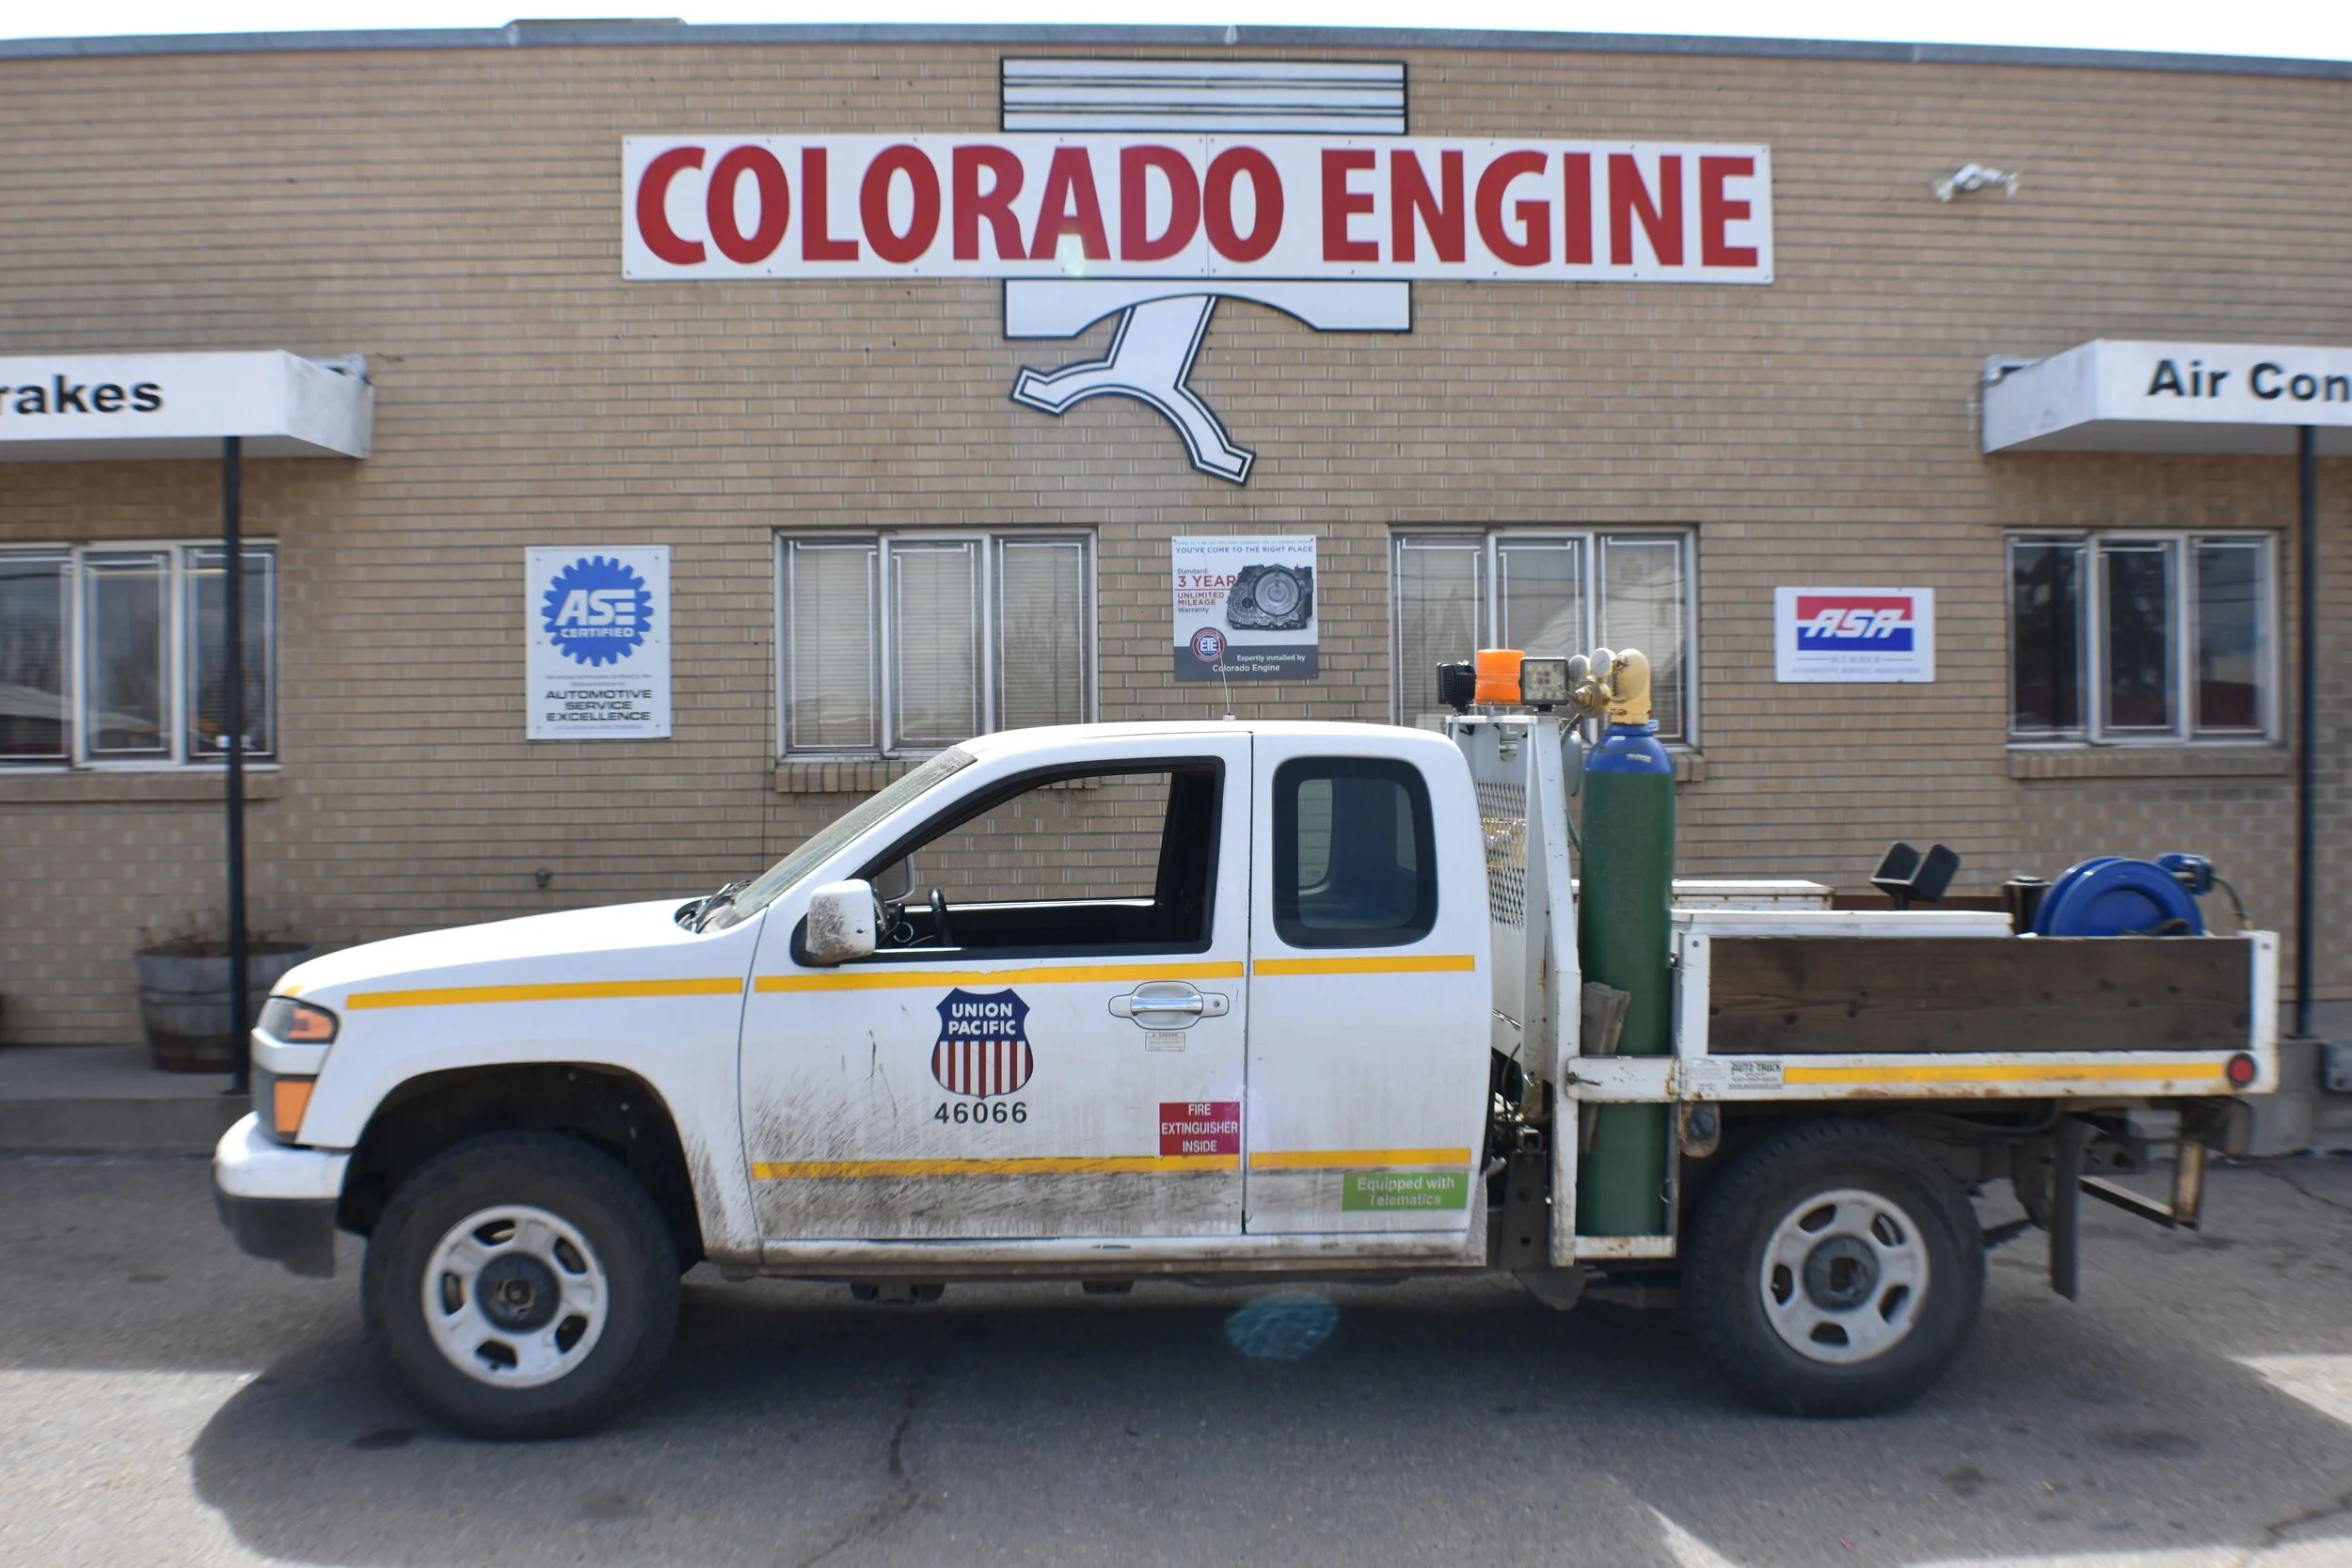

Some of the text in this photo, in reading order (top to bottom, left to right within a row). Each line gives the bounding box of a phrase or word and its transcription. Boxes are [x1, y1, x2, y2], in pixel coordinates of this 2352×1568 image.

[635, 143, 1759, 267] COLORADO ENGINE
[2145, 358, 2352, 403] Air Con
[1178, 575, 1236, 588] 3 YEAR
[554, 589, 637, 626] ASE
[1804, 608, 1905, 639] ASA
[560, 627, 635, 638] CERTIFIED
[1200, 637, 1217, 652] ETE
[545, 689, 653, 699] AUTOMOTIVE
[565, 701, 633, 710] SERVICE
[546, 712, 651, 721] EXCELLENCE
[951, 1003, 1013, 1018] UNION
[948, 1021, 1017, 1036] PACIFIC
[934, 1102, 1028, 1125] 46066
[1188, 1103, 1212, 1117] FIRE
[1161, 1120, 1239, 1135] EXTINGUISHER
[1182, 1139, 1217, 1153] INSIDE
[1358, 1175, 1455, 1193] Equipped with
[1371, 1193, 1441, 1207] Telematics
